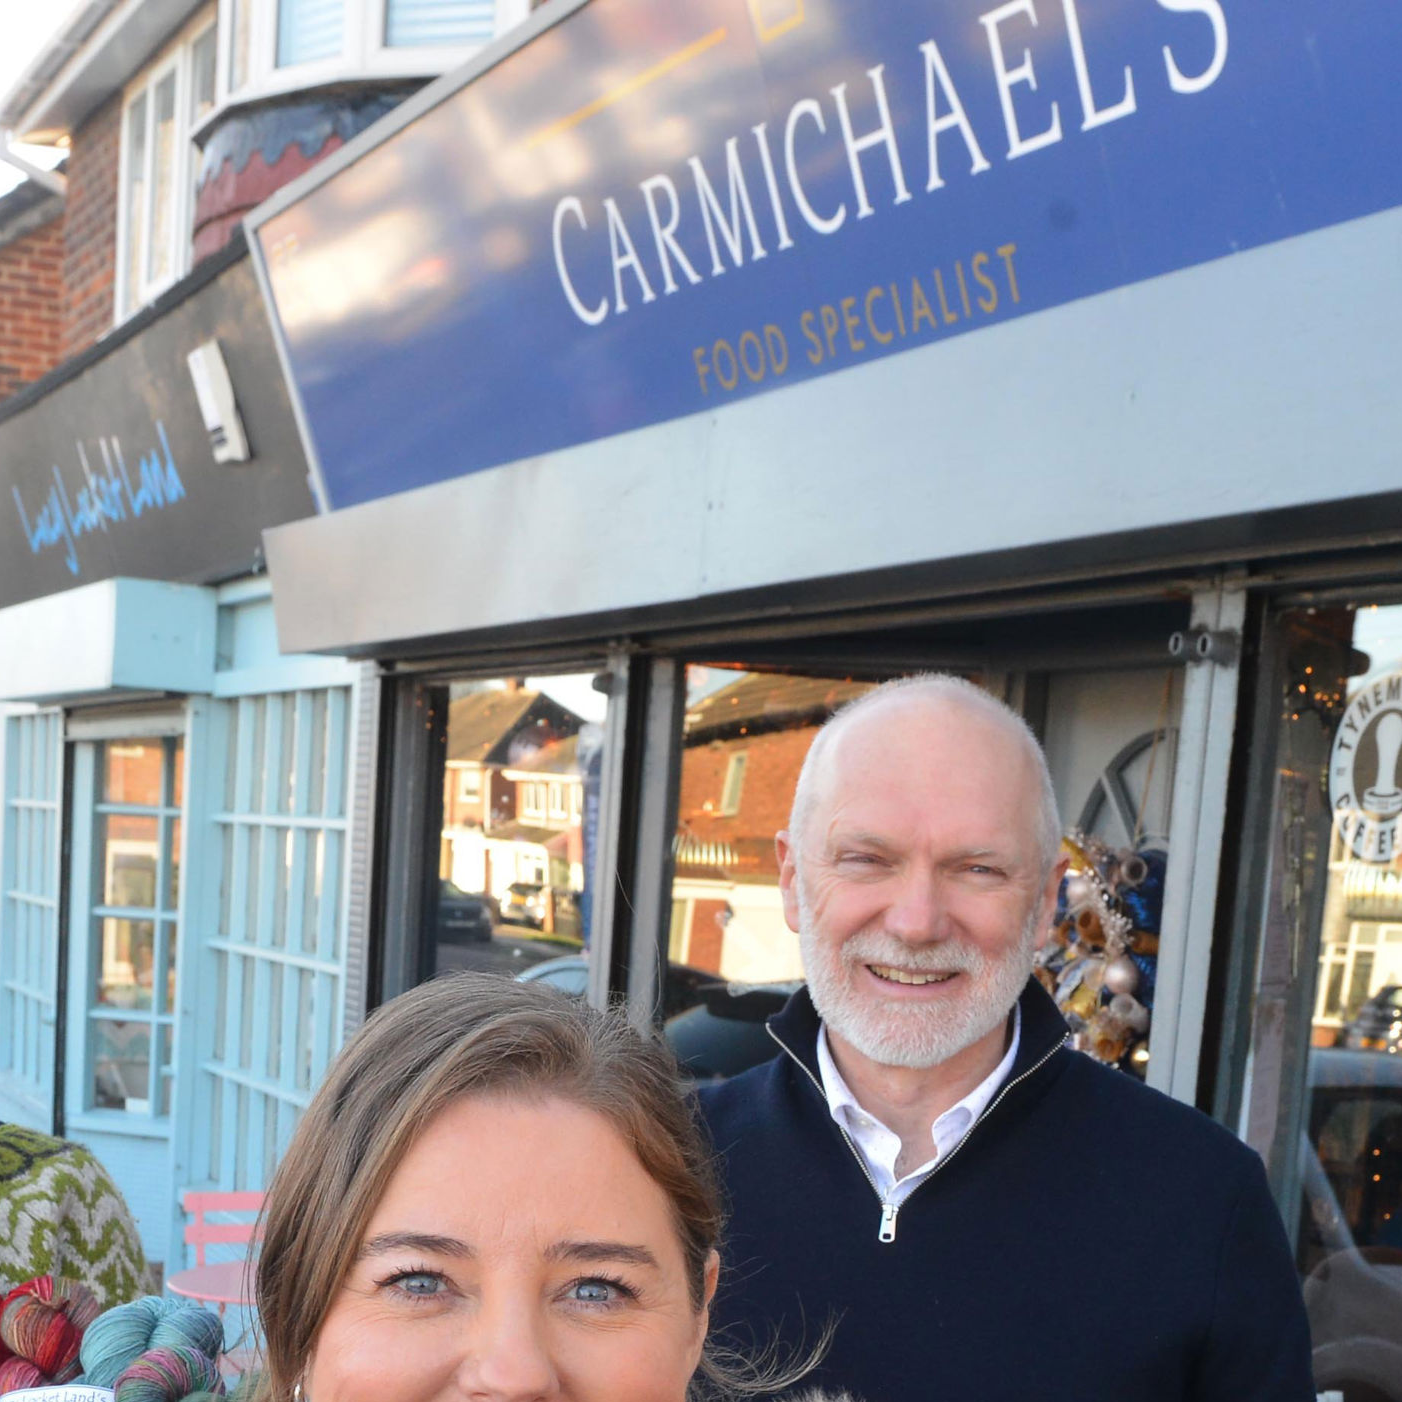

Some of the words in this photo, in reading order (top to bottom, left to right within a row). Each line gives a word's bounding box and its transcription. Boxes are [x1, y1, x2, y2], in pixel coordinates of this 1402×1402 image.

[552, 0, 1229, 326] CARMICHAELS
[693, 324, 789, 395] FOOD
[800, 243, 1018, 367] SPECIALIST
